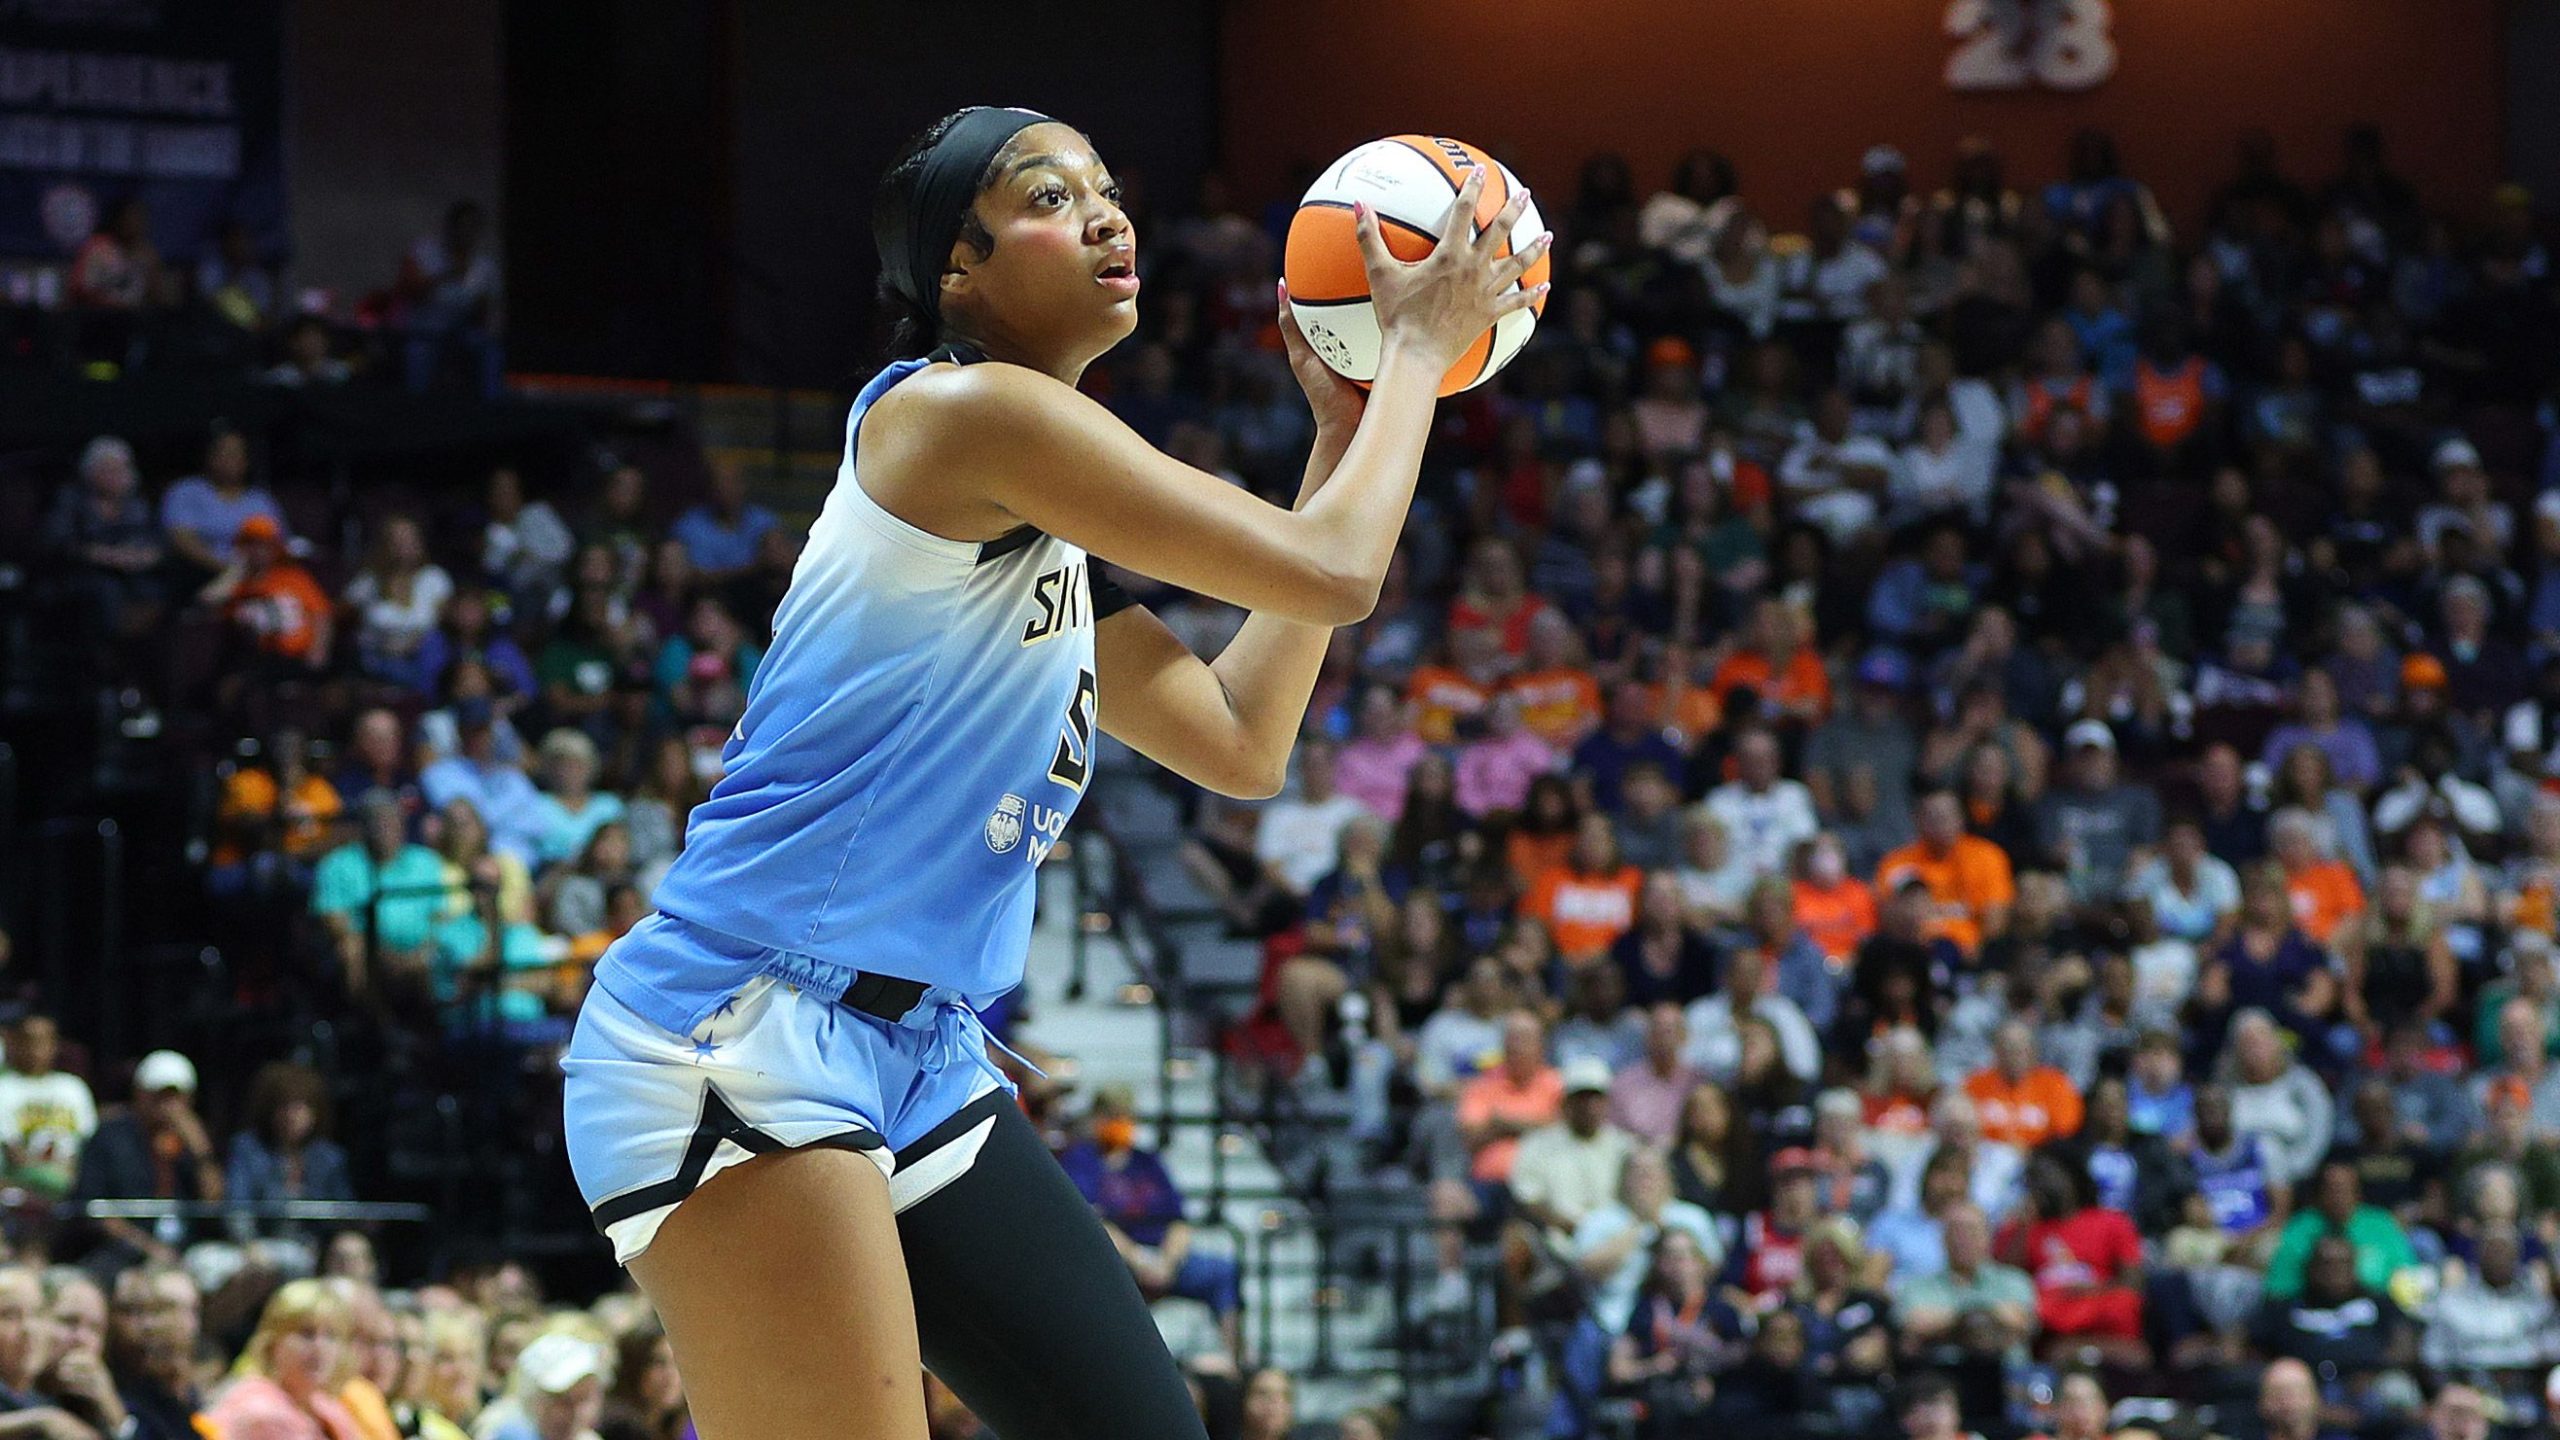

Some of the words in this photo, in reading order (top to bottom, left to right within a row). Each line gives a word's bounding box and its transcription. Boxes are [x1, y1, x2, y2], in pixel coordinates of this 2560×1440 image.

[1943, 0, 2119, 87] 28
[1047, 664, 1098, 795] 5
[1033, 804, 1067, 840] UC
